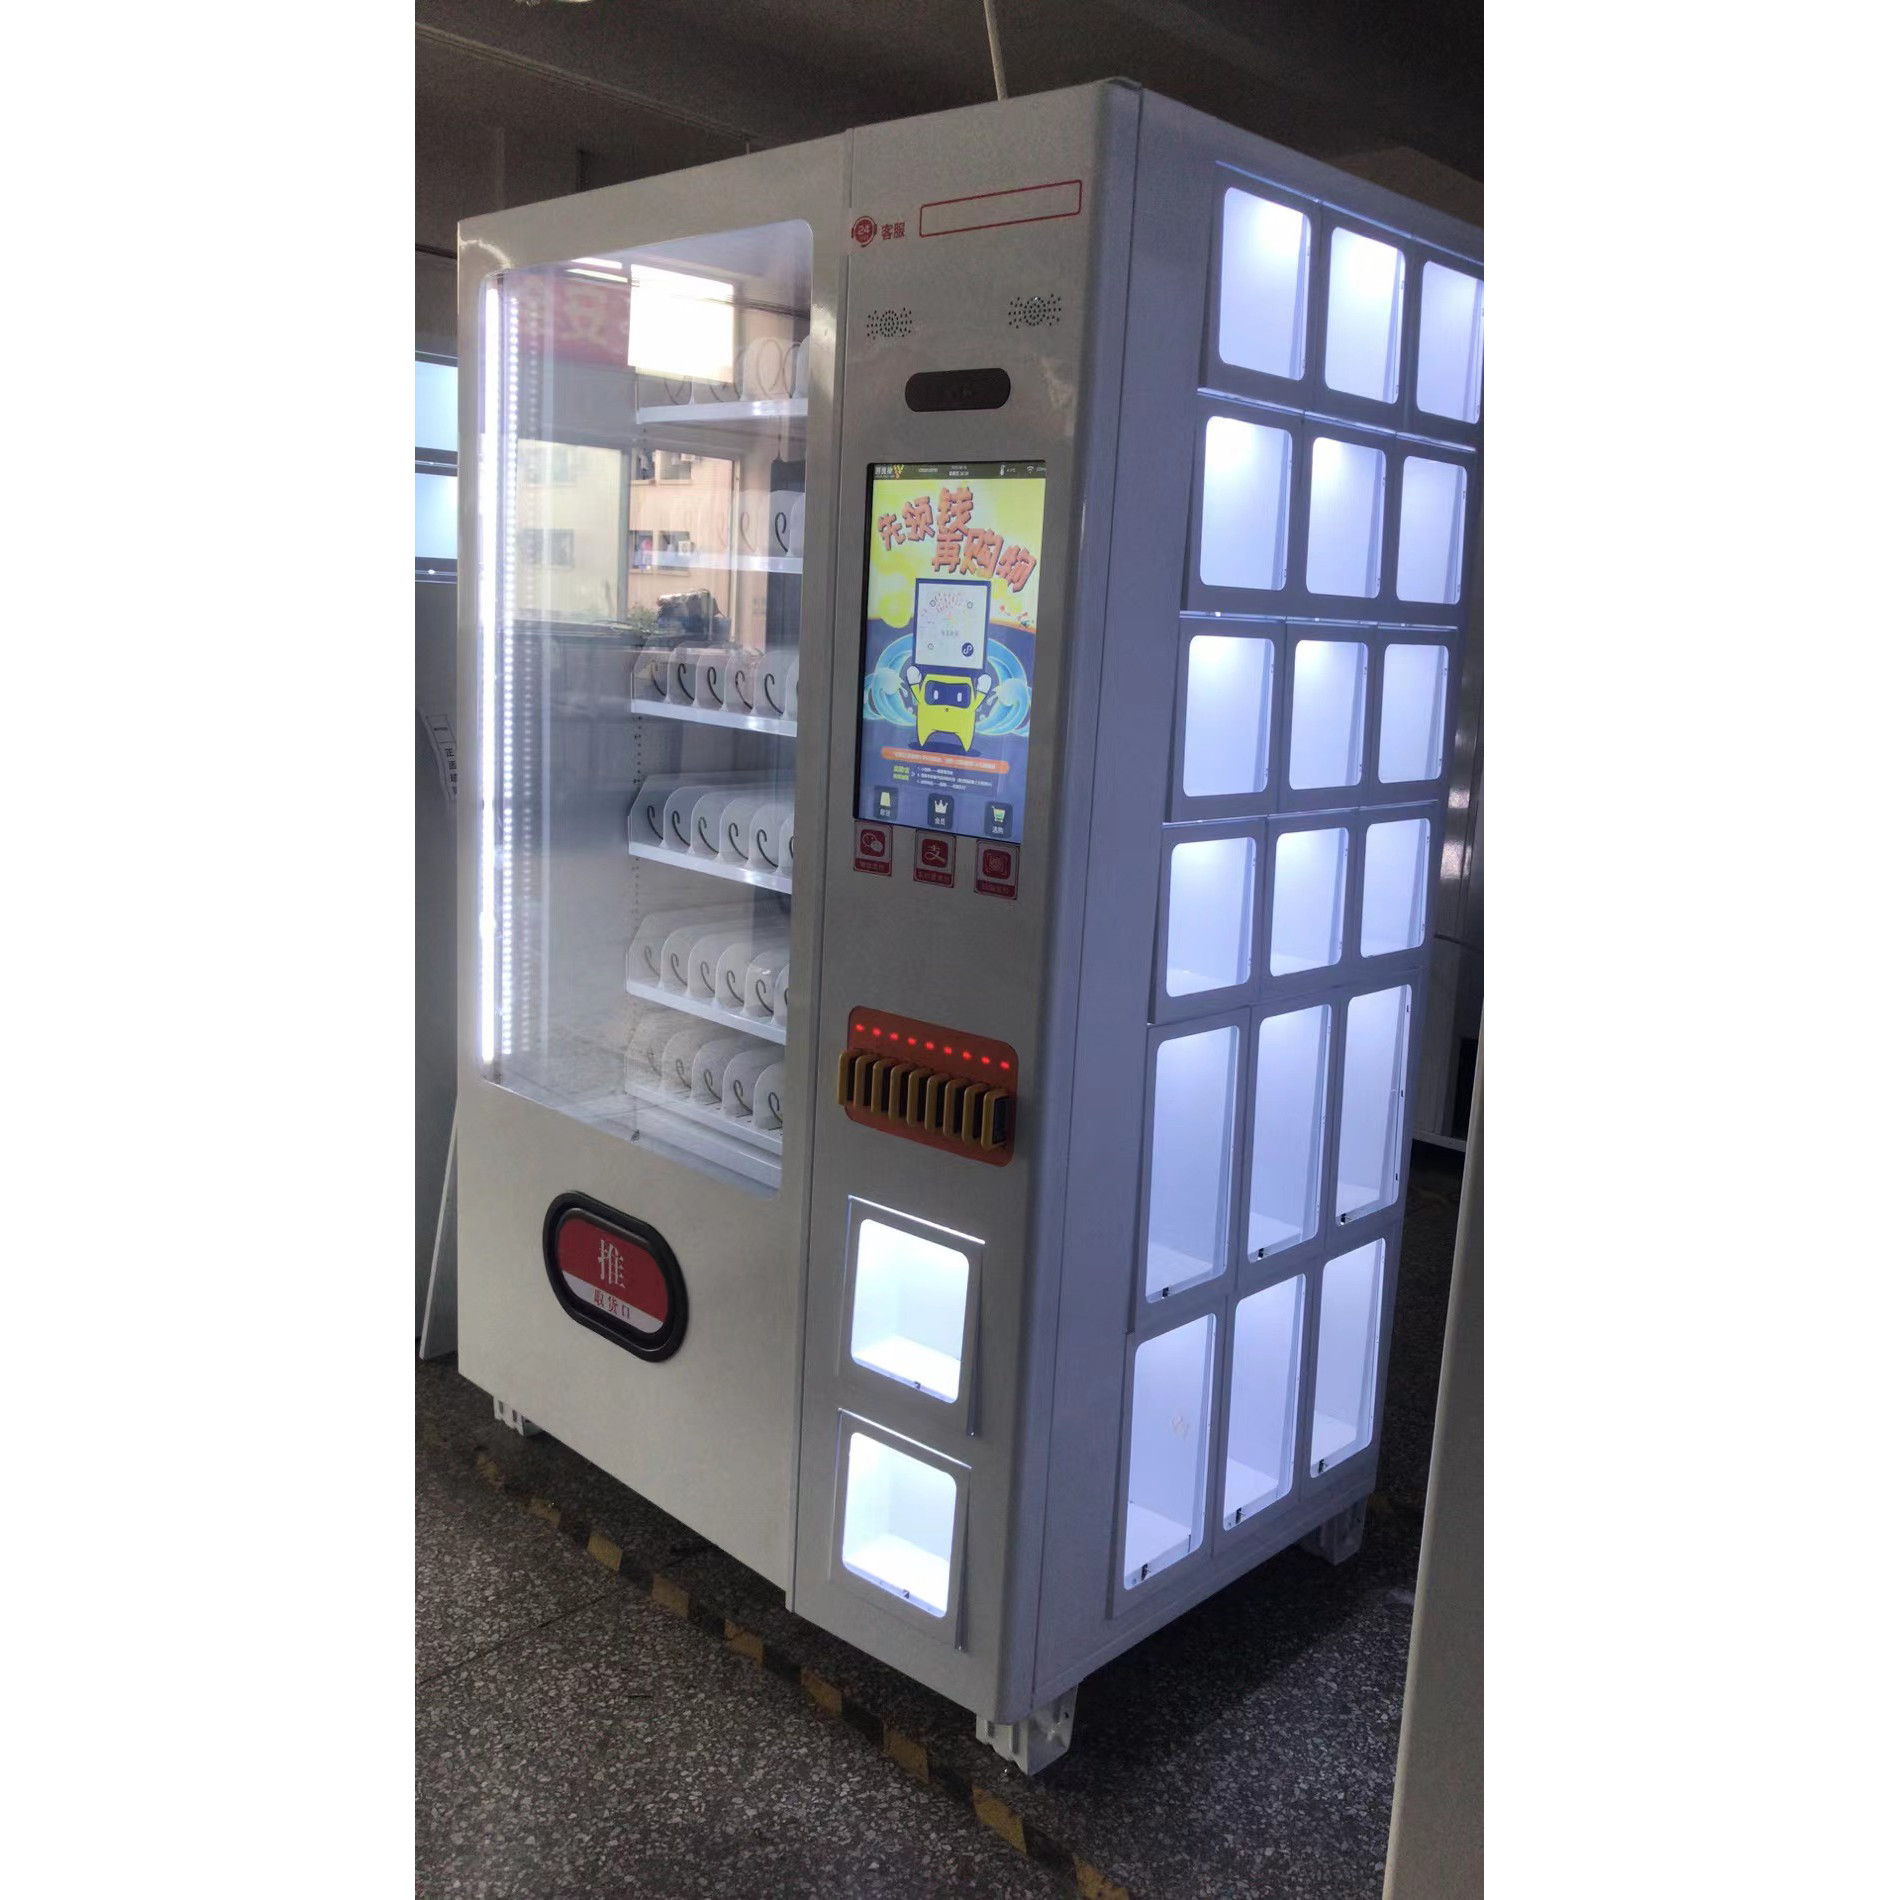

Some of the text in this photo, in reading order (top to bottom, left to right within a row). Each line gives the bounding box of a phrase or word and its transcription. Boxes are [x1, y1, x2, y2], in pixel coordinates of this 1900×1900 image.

[881, 222, 905, 240] 客服
[878, 487, 974, 551] 先领钱
[931, 527, 1037, 593] 再购物
[597, 1239, 626, 1288] 推
[594, 1289, 630, 1319] 取货口
